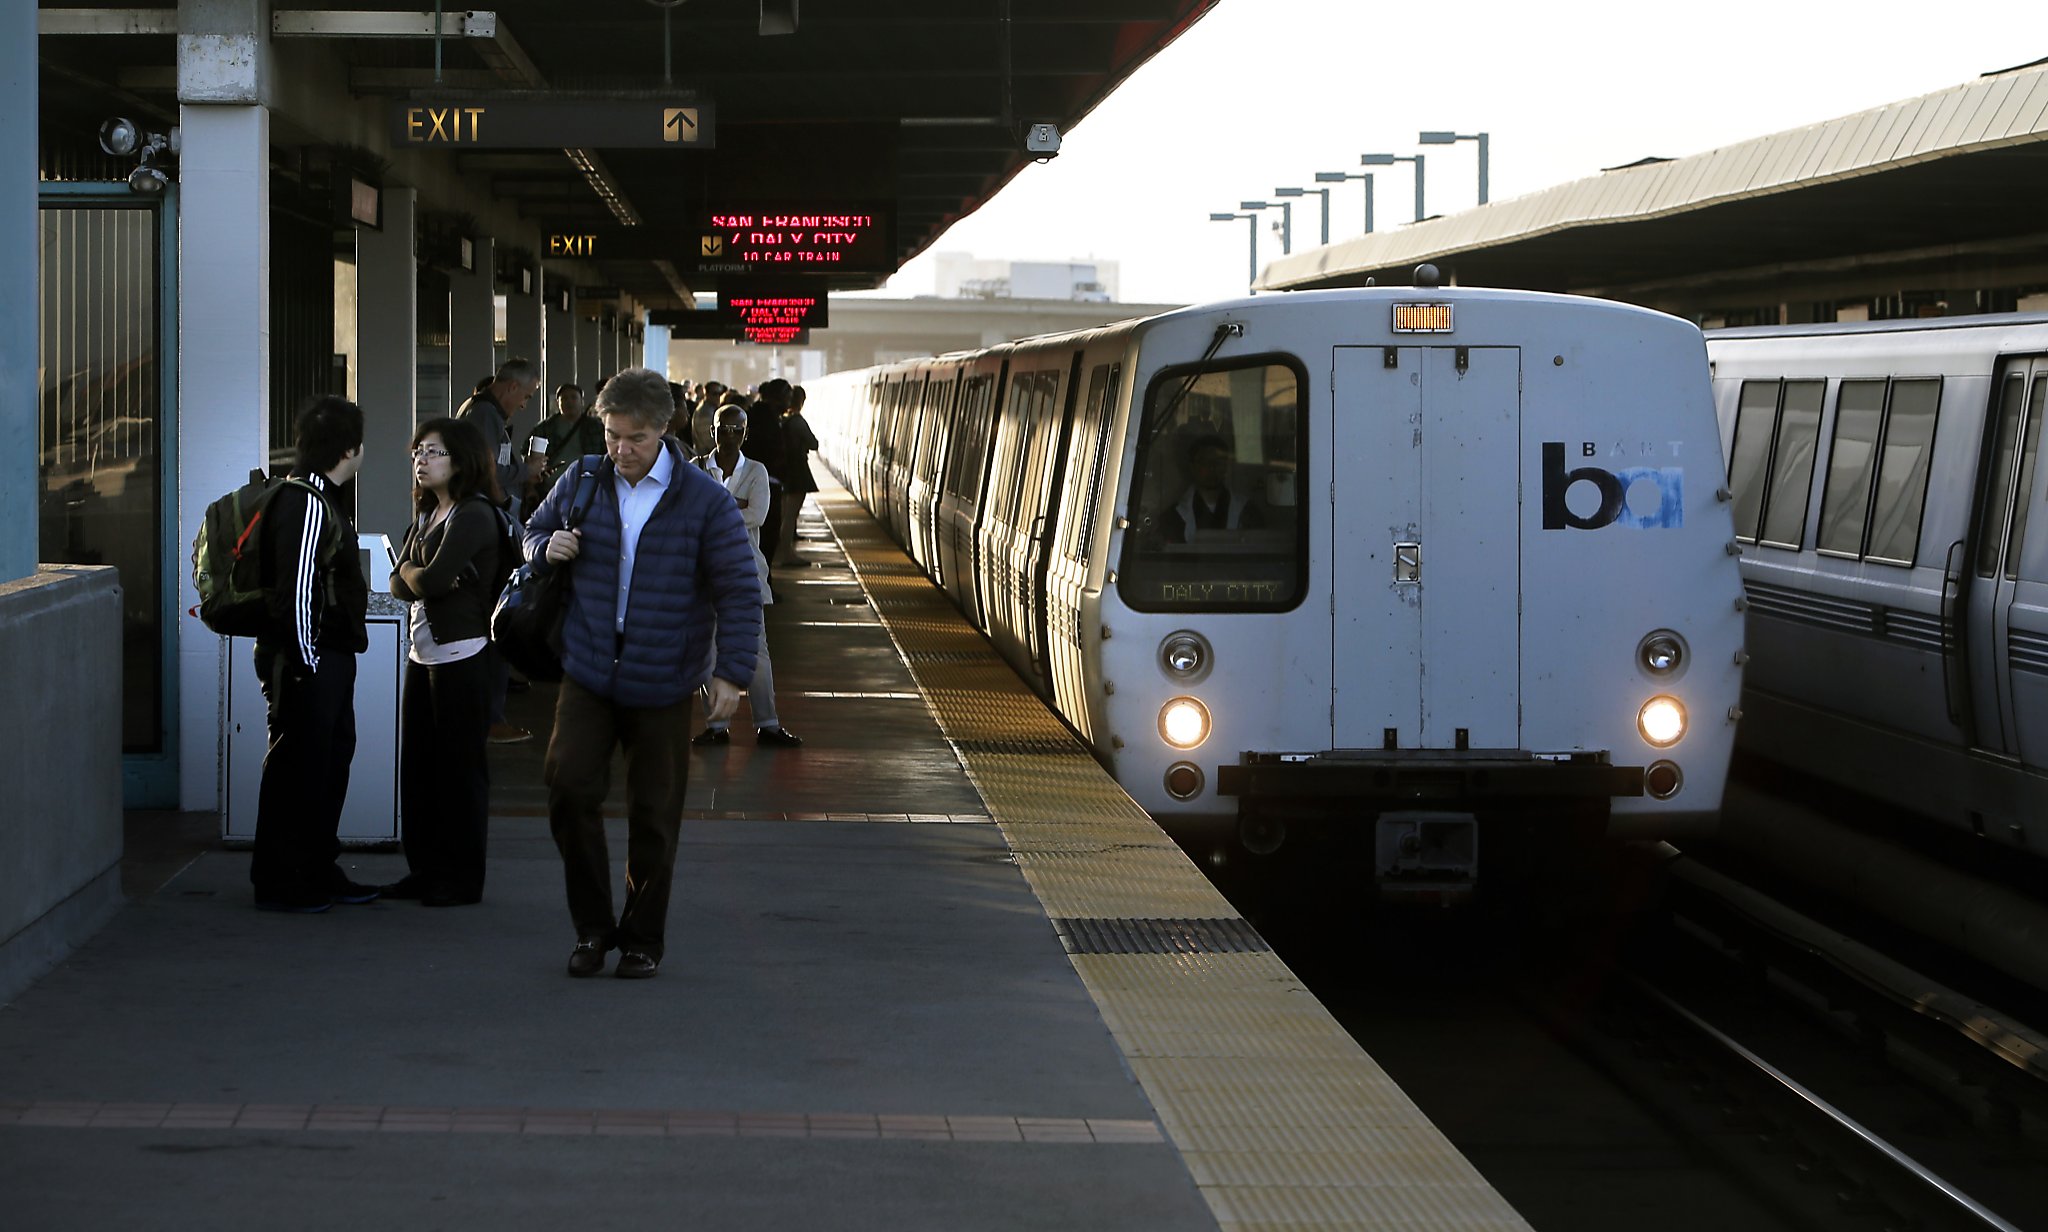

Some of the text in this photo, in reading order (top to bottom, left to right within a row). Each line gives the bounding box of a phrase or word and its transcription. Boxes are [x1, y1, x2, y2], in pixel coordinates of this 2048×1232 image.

[407, 107, 486, 142] EXIT
[712, 215, 871, 227] SAN FRANCISCO
[750, 232, 803, 244] DALY
[814, 232, 857, 244] CITY
[550, 235, 597, 256] EXIT
[743, 251, 841, 262] 10 CAR TRAIN
[697, 263, 745, 272] PLATFORM
[1162, 584, 1278, 601] DALY CITY
